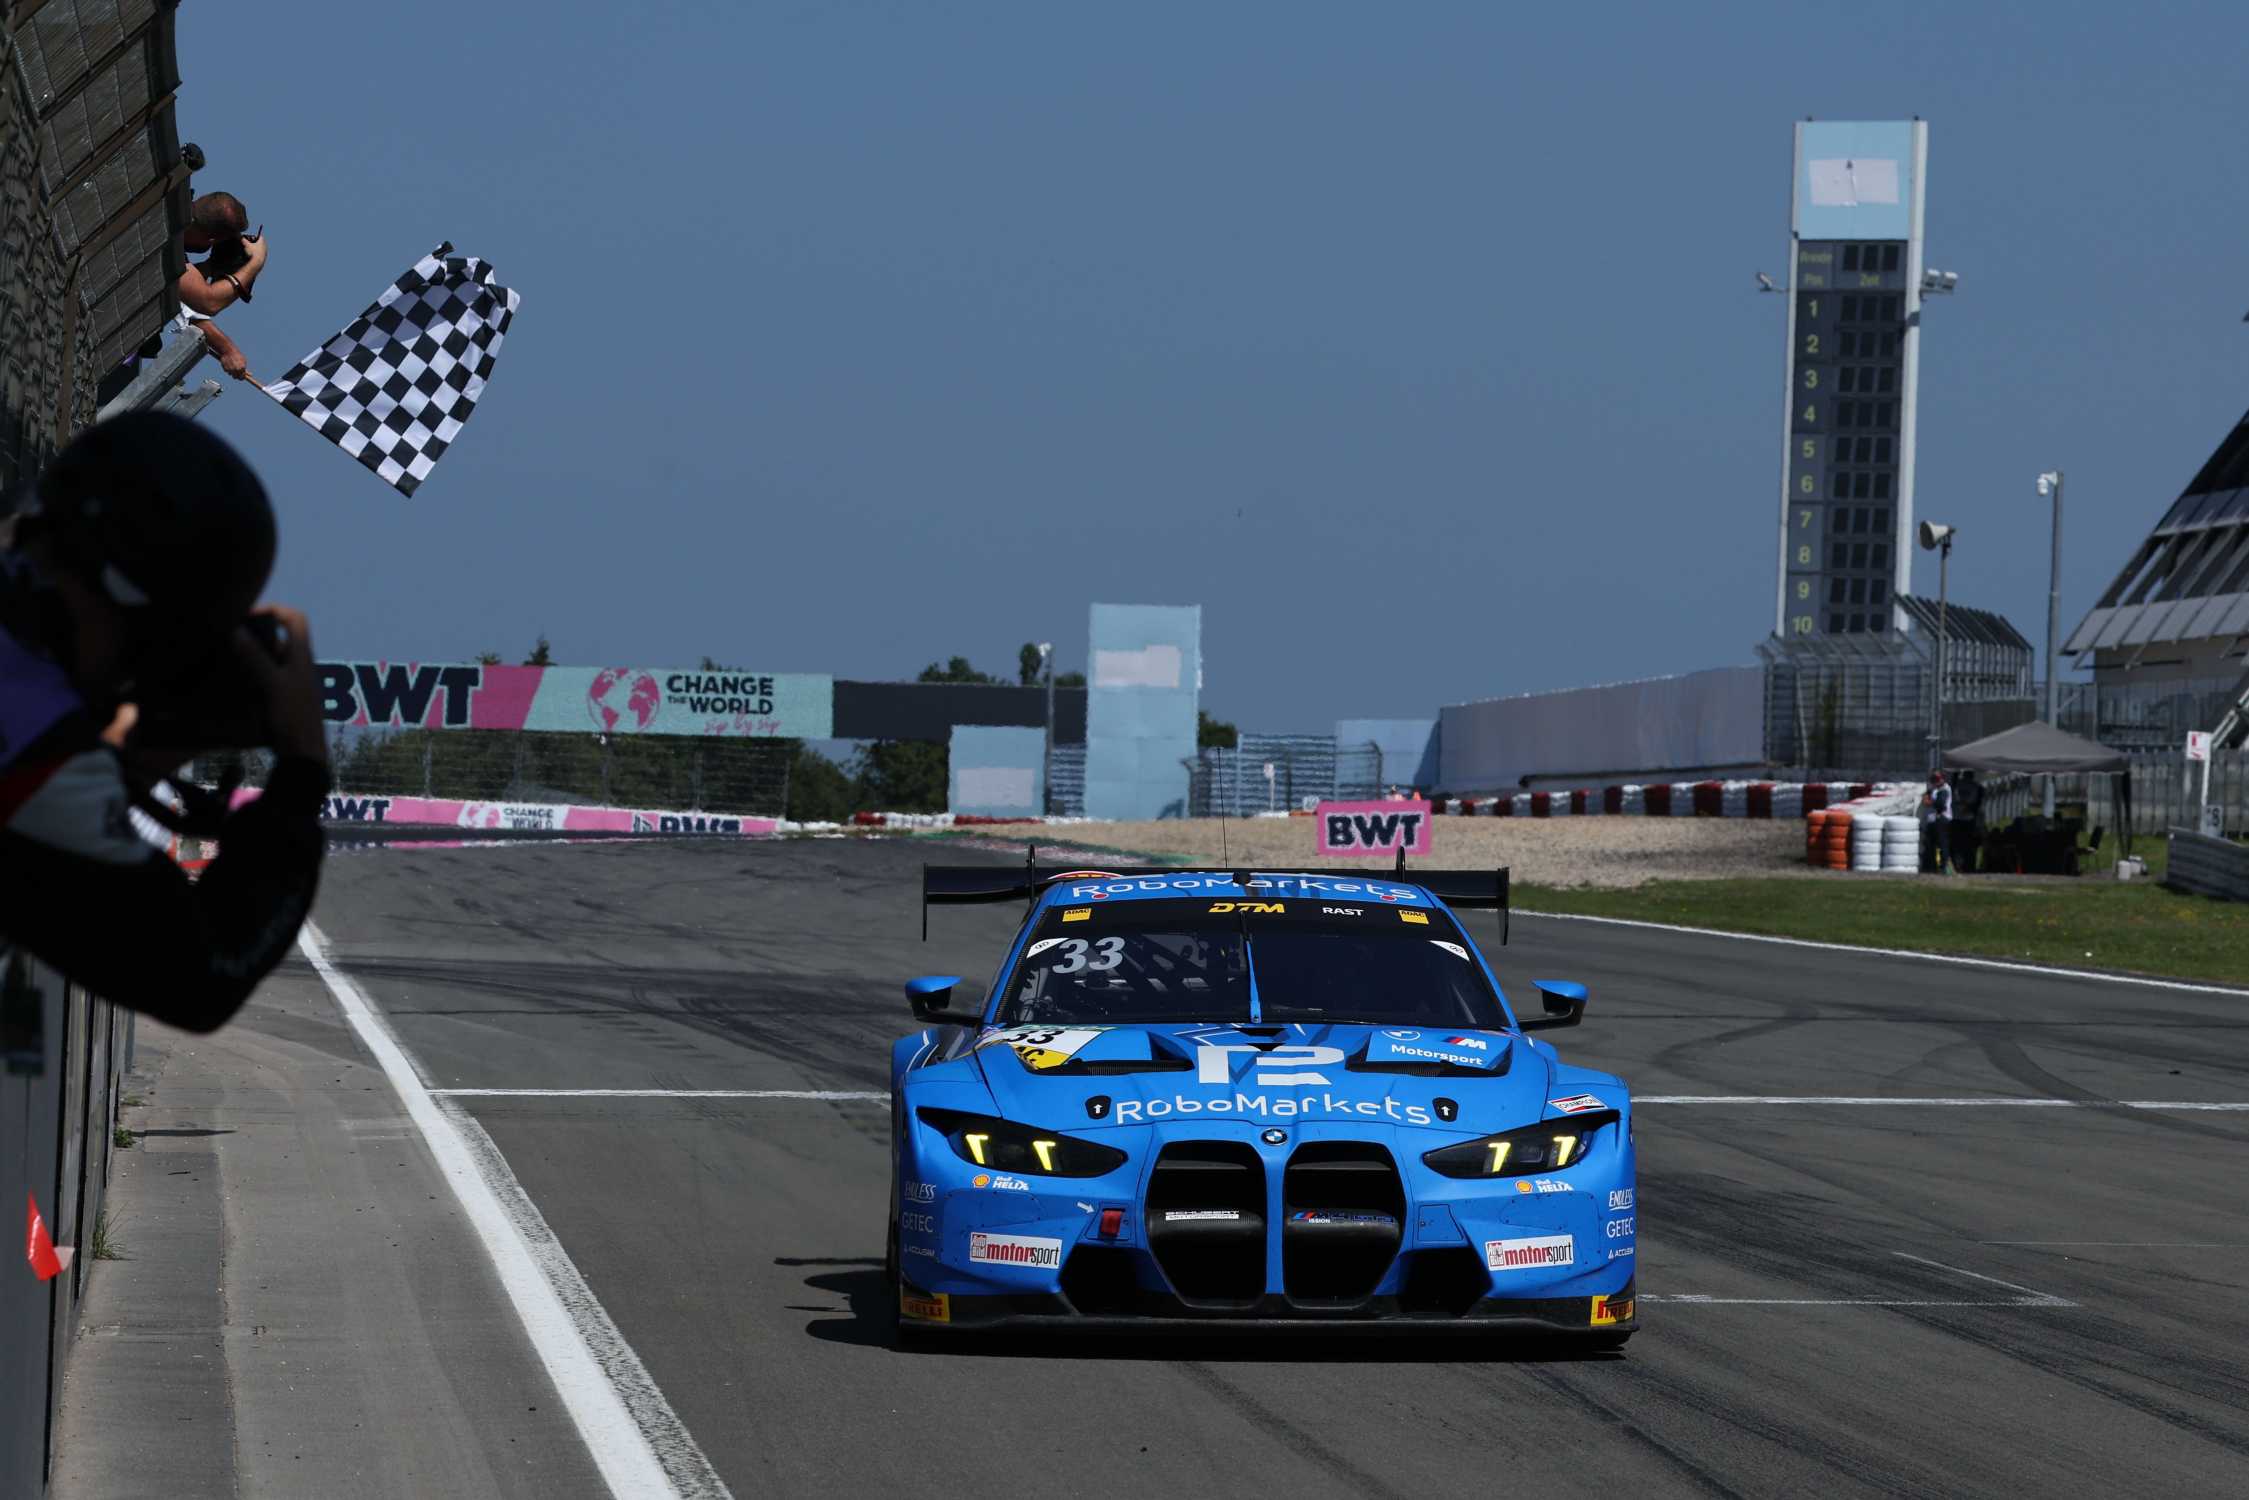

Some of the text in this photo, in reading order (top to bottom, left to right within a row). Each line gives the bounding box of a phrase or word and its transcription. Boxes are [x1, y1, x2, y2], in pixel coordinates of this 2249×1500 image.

[1809, 299, 1818, 319] 1
[1807, 334, 1819, 354] 2
[1805, 369, 1818, 389] 3
[1803, 404, 1816, 422] 4
[1802, 439, 1815, 458] 5
[1800, 474, 1814, 493] 6
[1800, 509, 1813, 528] 7
[1798, 544, 1811, 564] 8
[1797, 581, 1810, 599] 9
[1792, 615, 1813, 635] 10
[315, 663, 480, 726] BWT
[666, 674, 774, 697] CHANGE
[688, 696, 773, 715] WORLD
[504, 807, 553, 818] CHANGE
[1327, 813, 1420, 848] BWT
[1072, 877, 1417, 900] RoboMarkets
[1208, 902, 1285, 913] DTM
[1323, 907, 1364, 916] RAST
[1052, 936, 1126, 974] 33
[1391, 1044, 1483, 1066] Motorsport
[1116, 1094, 1431, 1125] RoboMarkets
[992, 1180, 1030, 1191] HELIX
[1609, 1189, 1633, 1207] ENDLESS
[903, 1212, 934, 1233] GETEC
[1606, 1217, 1634, 1239] GETEC
[986, 1243, 1059, 1266] motorsport
[1504, 1241, 1572, 1266] motorsport
